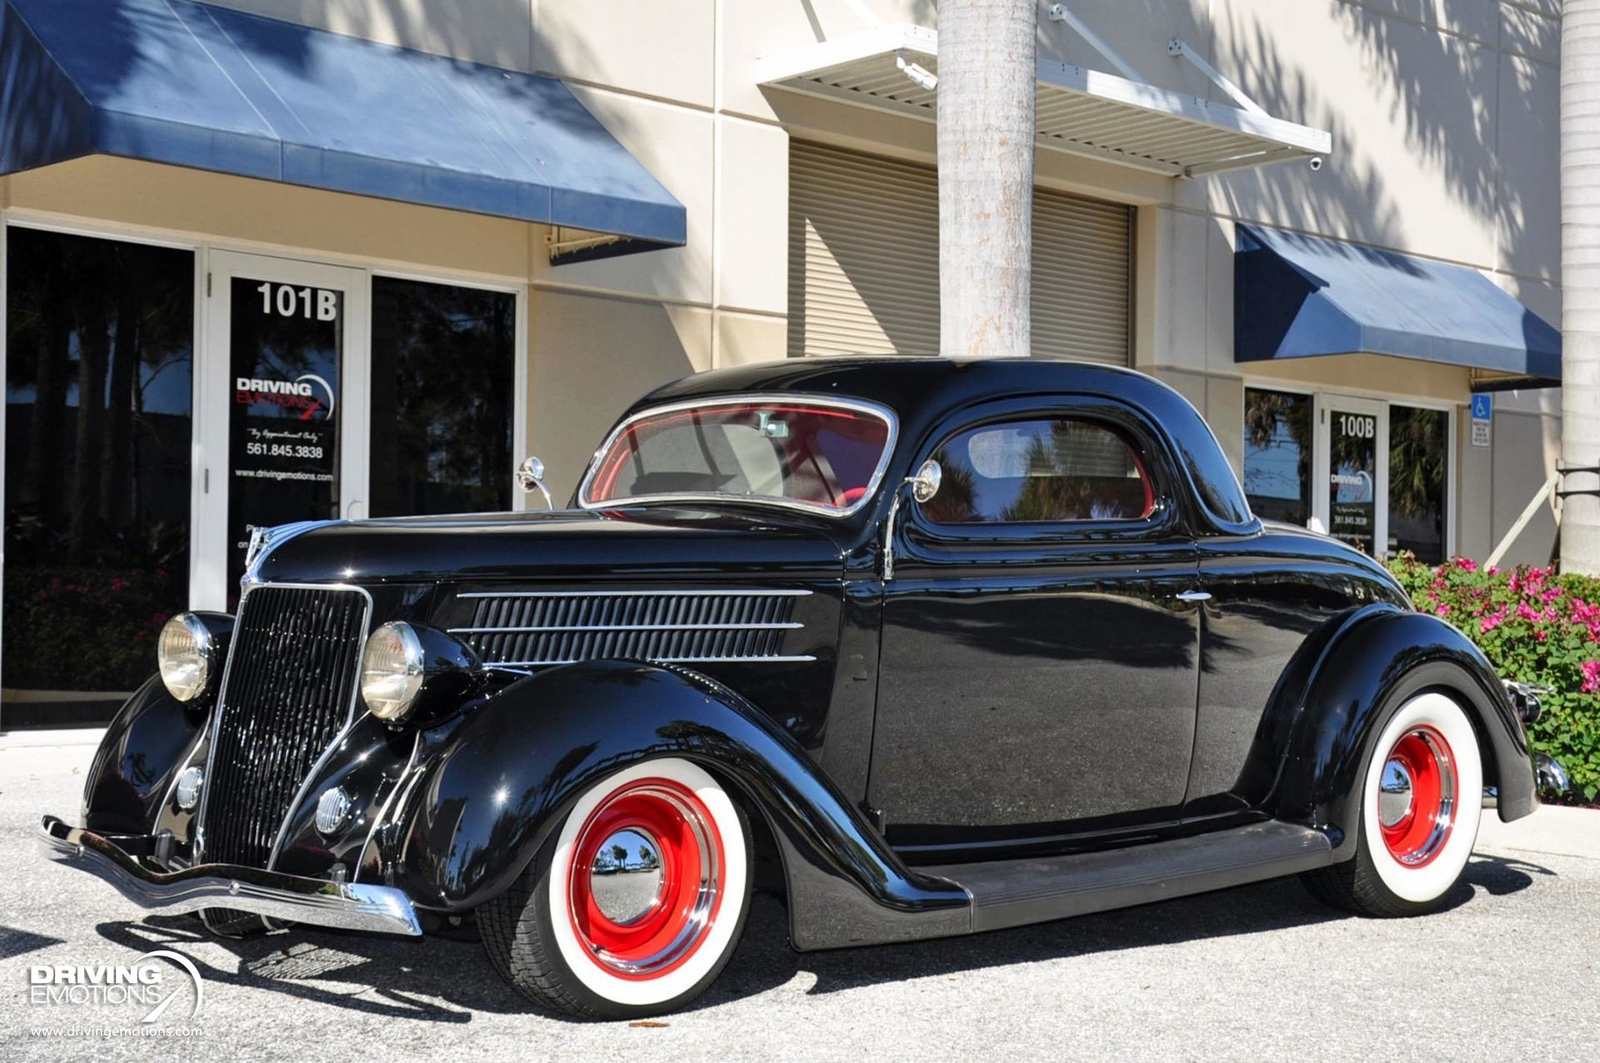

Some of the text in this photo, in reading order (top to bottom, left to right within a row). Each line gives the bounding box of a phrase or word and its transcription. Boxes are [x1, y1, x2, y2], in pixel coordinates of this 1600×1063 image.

[257, 283, 337, 321] 101B
[236, 378, 312, 396] DRIVING
[236, 391, 312, 408] EMOTIONS
[1339, 414, 1374, 438] 100B
[247, 443, 323, 458] 561.845.3838
[235, 469, 334, 481] www.drivingemotions.com
[1331, 474, 1363, 486] DRIVING
